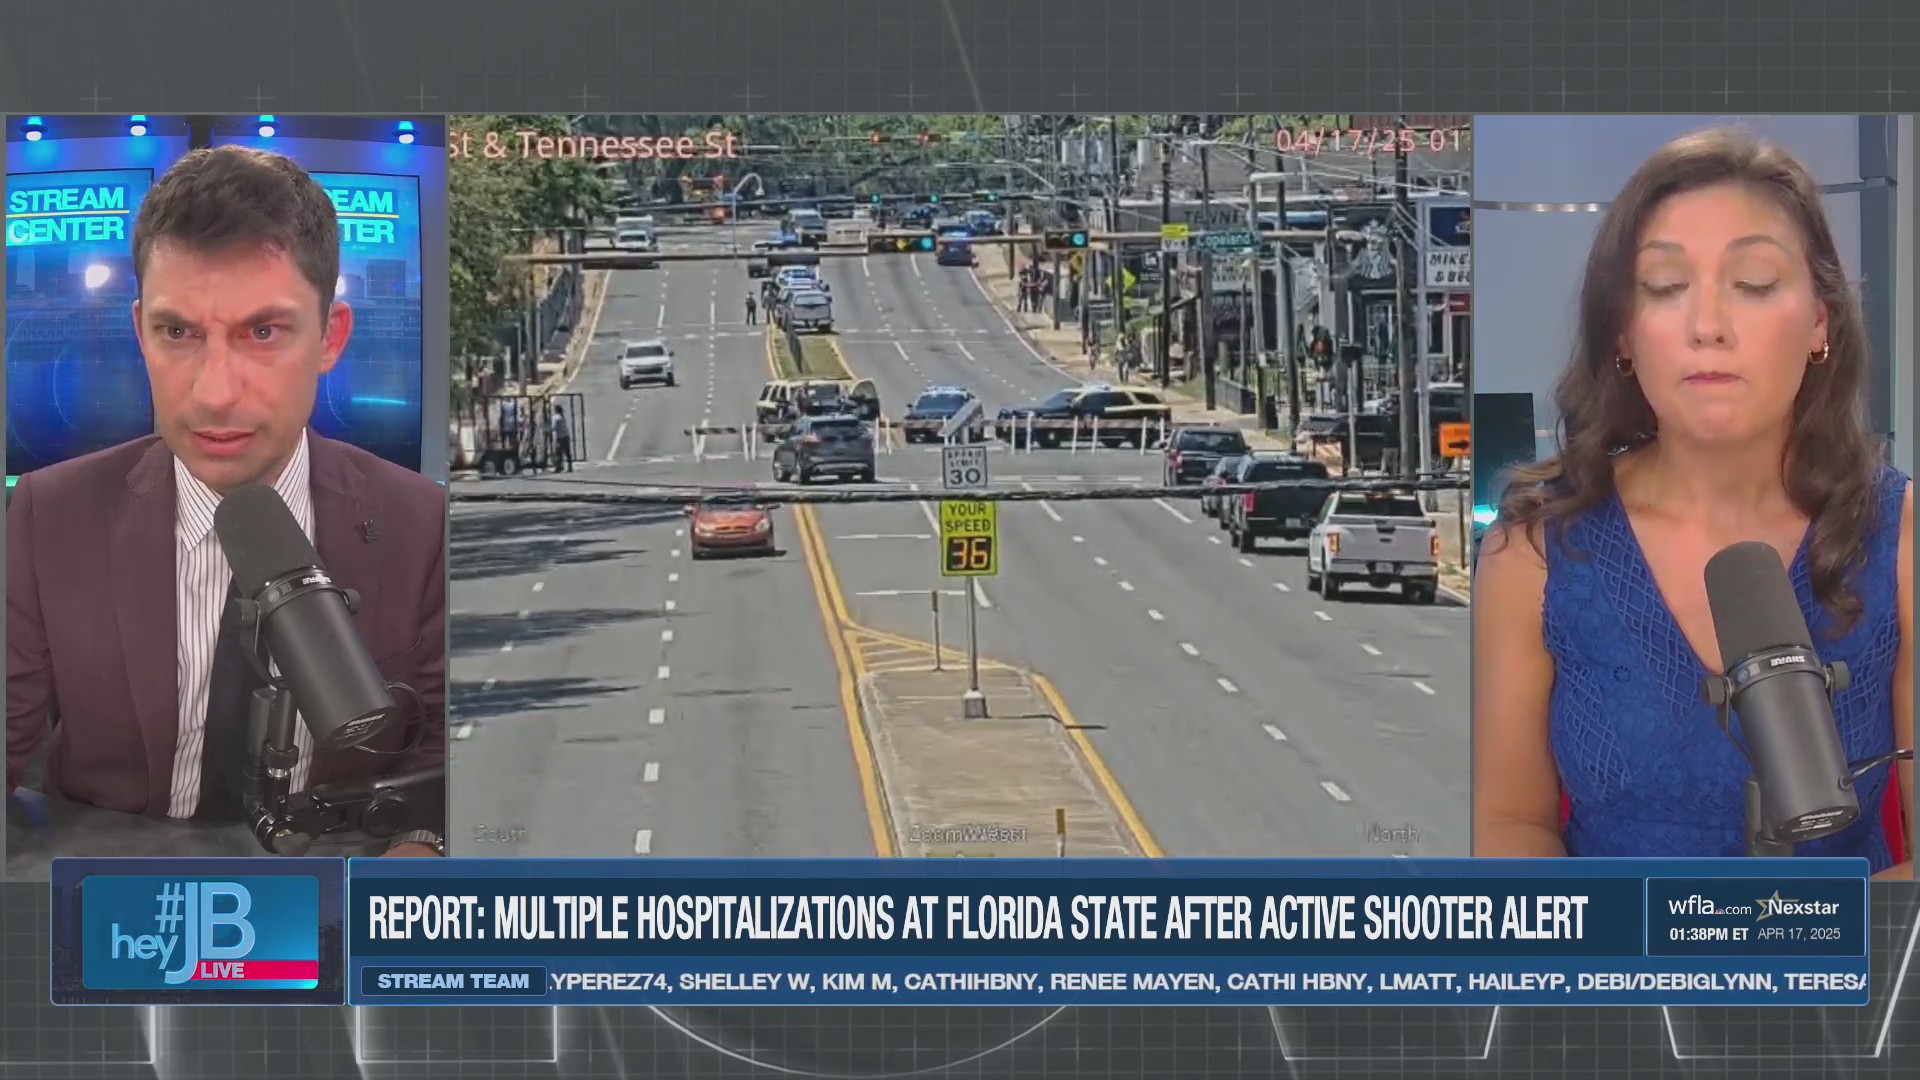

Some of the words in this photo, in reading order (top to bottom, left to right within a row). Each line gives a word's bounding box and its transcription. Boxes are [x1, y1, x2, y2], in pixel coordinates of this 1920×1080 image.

[9, 186, 124, 213] STREAM
[8, 216, 125, 243] CENTER
[950, 468, 981, 484] 30
[948, 502, 987, 517] YOUR
[944, 518, 992, 533] SPEED
[951, 538, 989, 570] 36
[1770, 655, 1806, 667] SHURE
